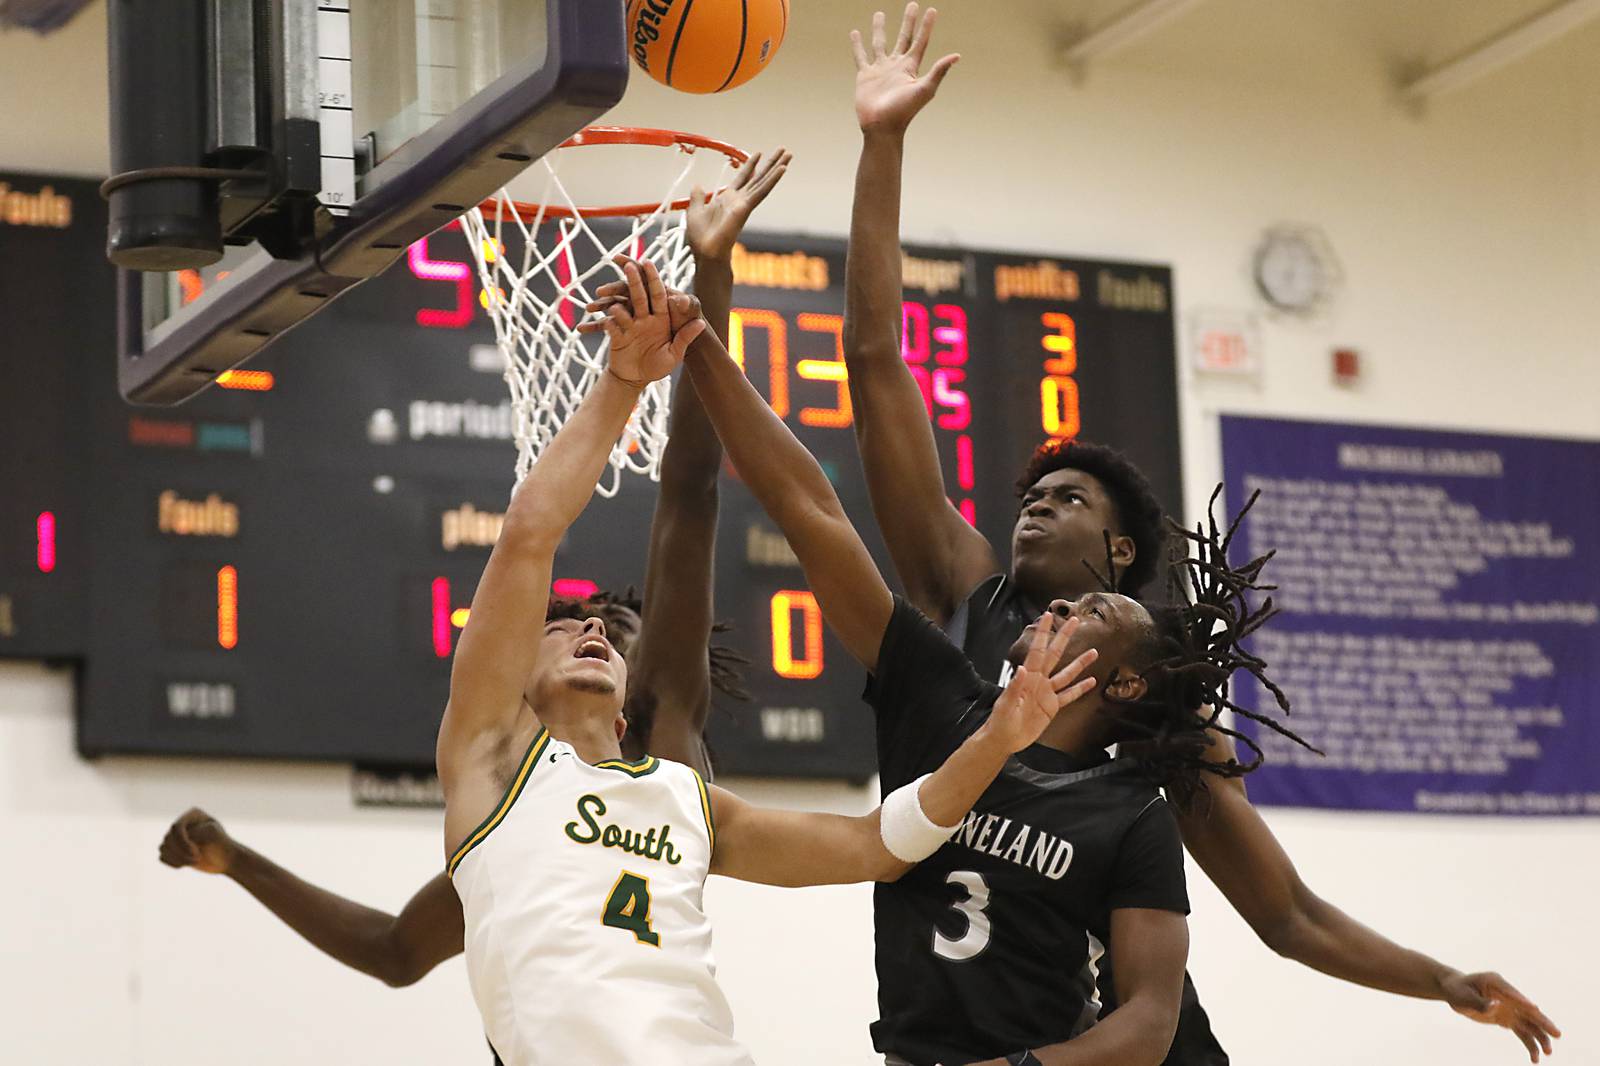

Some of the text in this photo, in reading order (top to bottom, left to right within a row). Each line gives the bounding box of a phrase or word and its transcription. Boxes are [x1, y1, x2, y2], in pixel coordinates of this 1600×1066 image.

[771, 590, 825, 679] 0
[564, 793, 682, 866] South
[955, 811, 1074, 880] NELAND
[601, 869, 662, 949] 4
[932, 869, 992, 962] 3
